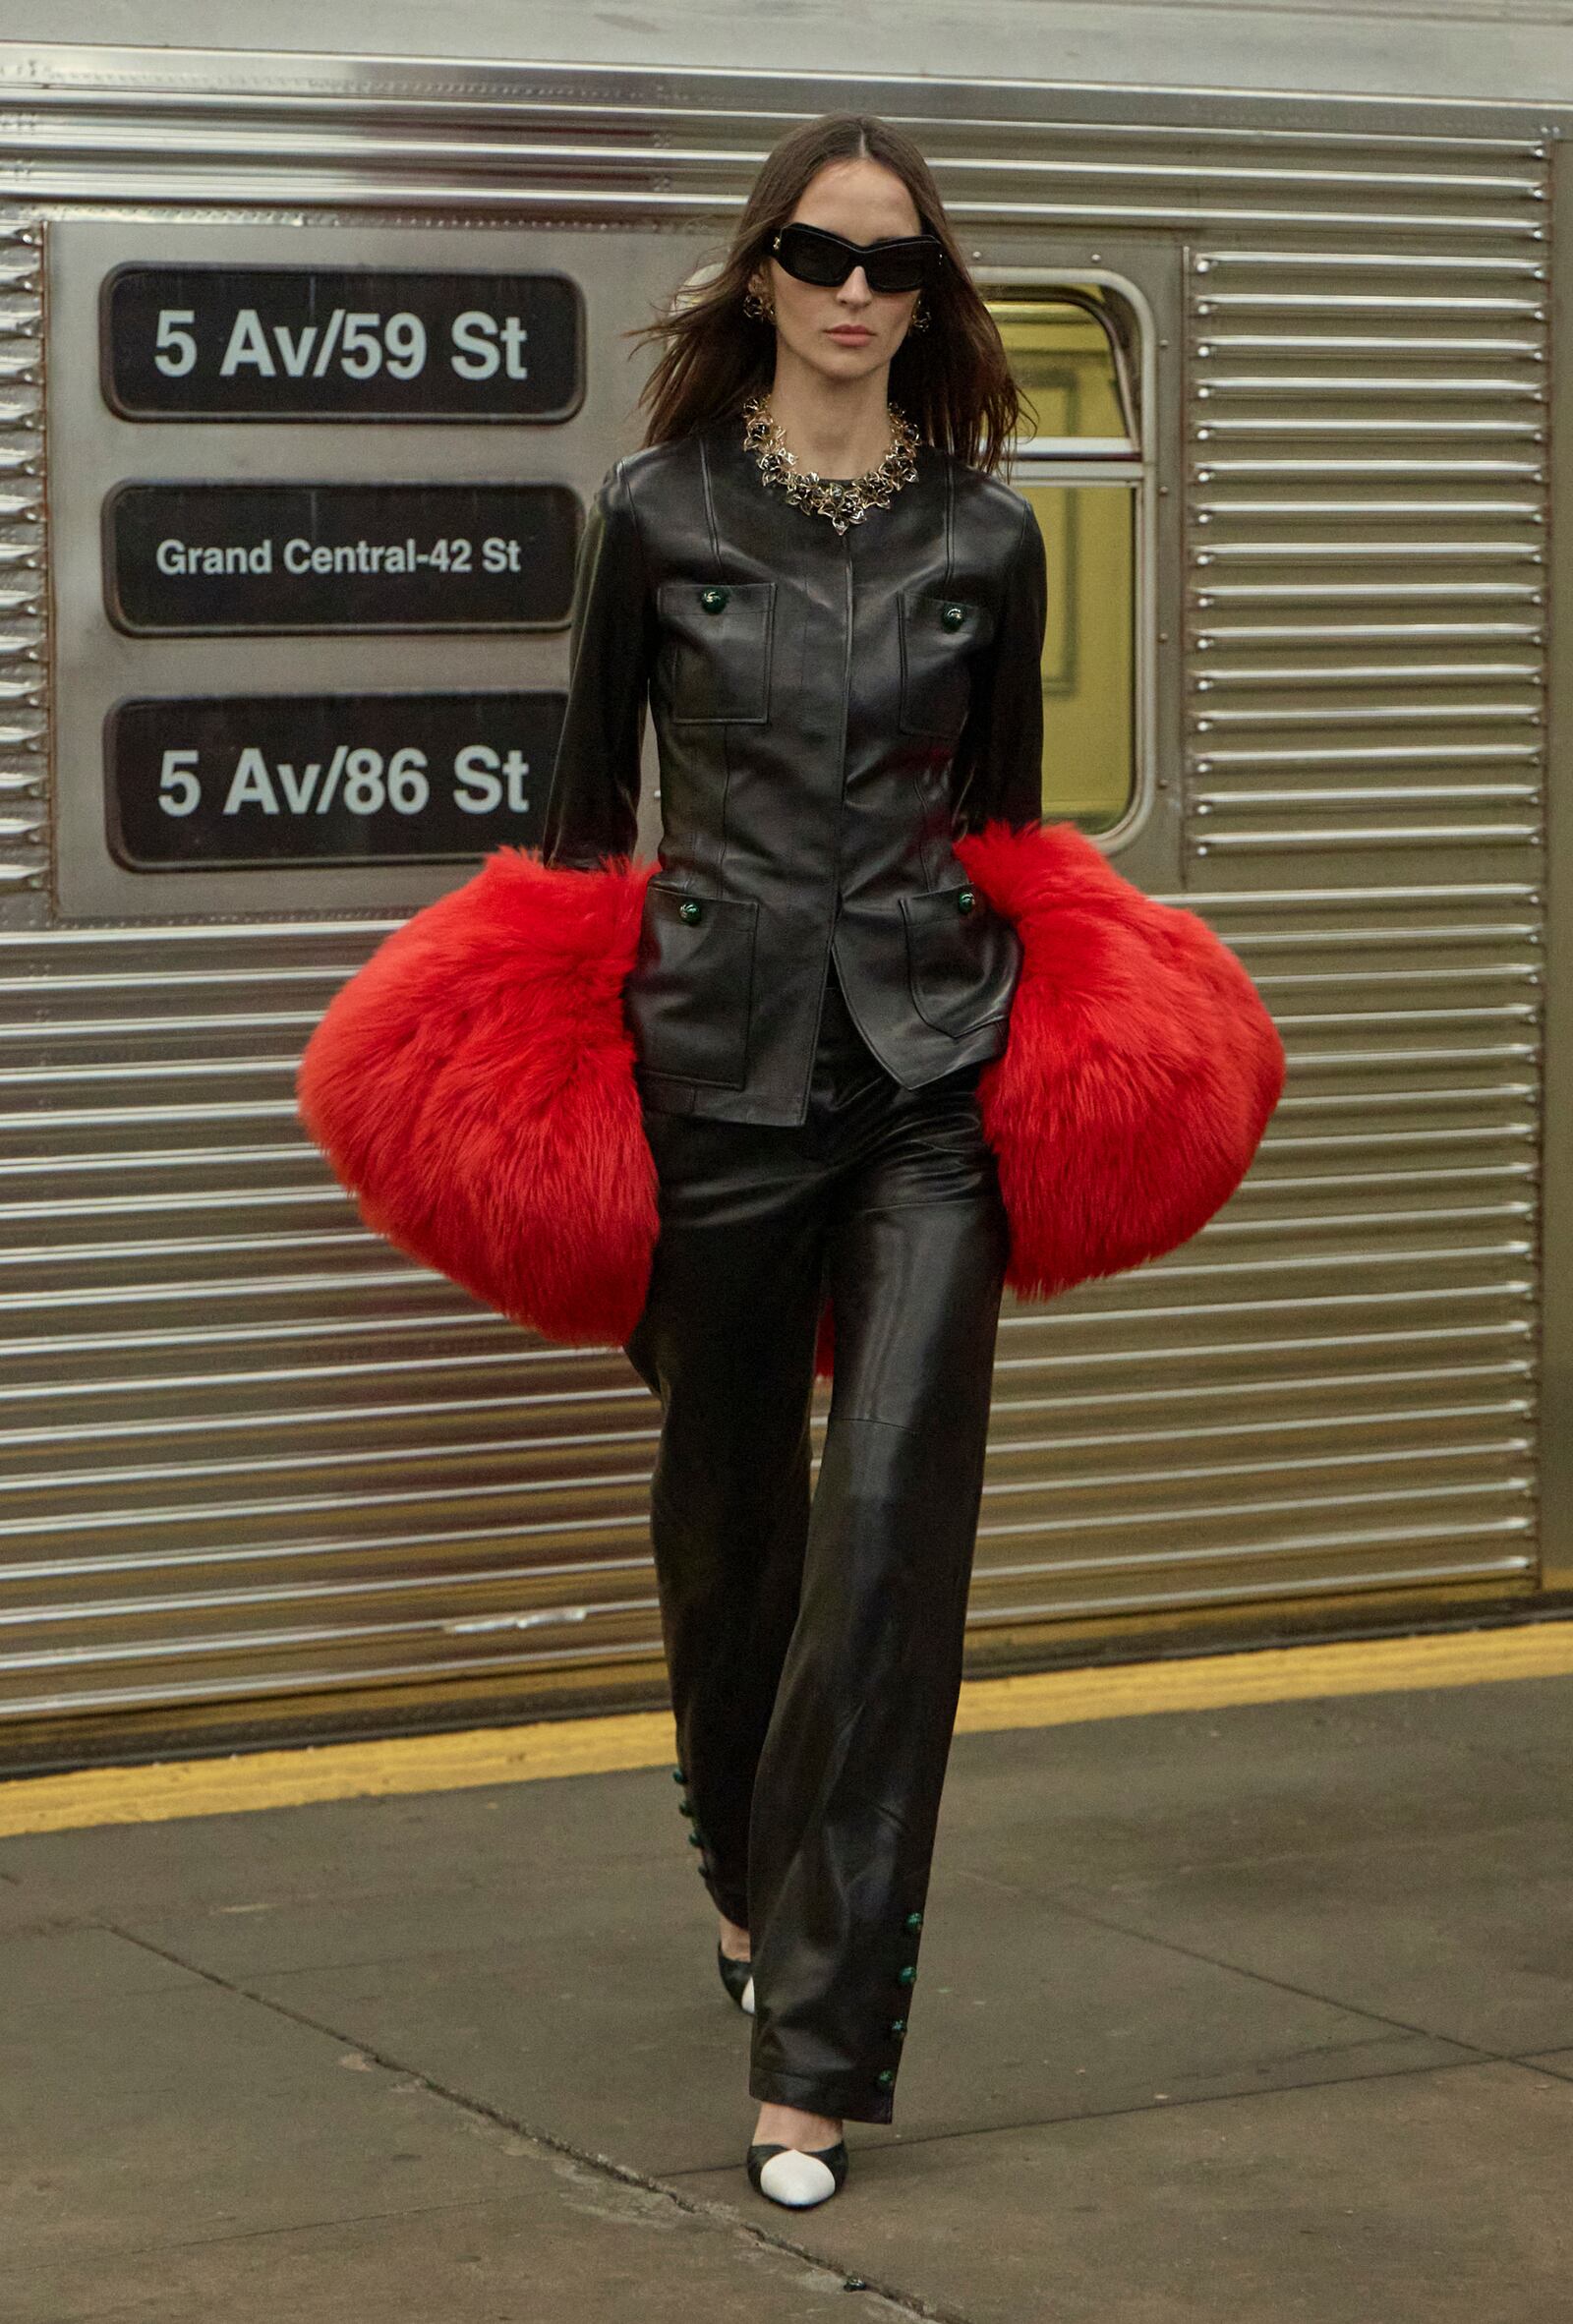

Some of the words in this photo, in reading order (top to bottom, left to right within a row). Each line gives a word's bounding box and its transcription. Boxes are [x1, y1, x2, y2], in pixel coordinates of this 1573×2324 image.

[154, 309, 197, 377] 5
[219, 309, 427, 380] Av/59
[451, 311, 528, 380] St
[156, 539, 271, 574] Grand
[283, 538, 472, 574] Central-42
[483, 537, 521, 573] St
[158, 749, 201, 816] 5
[223, 745, 429, 815] Av/86
[453, 745, 529, 814] St
